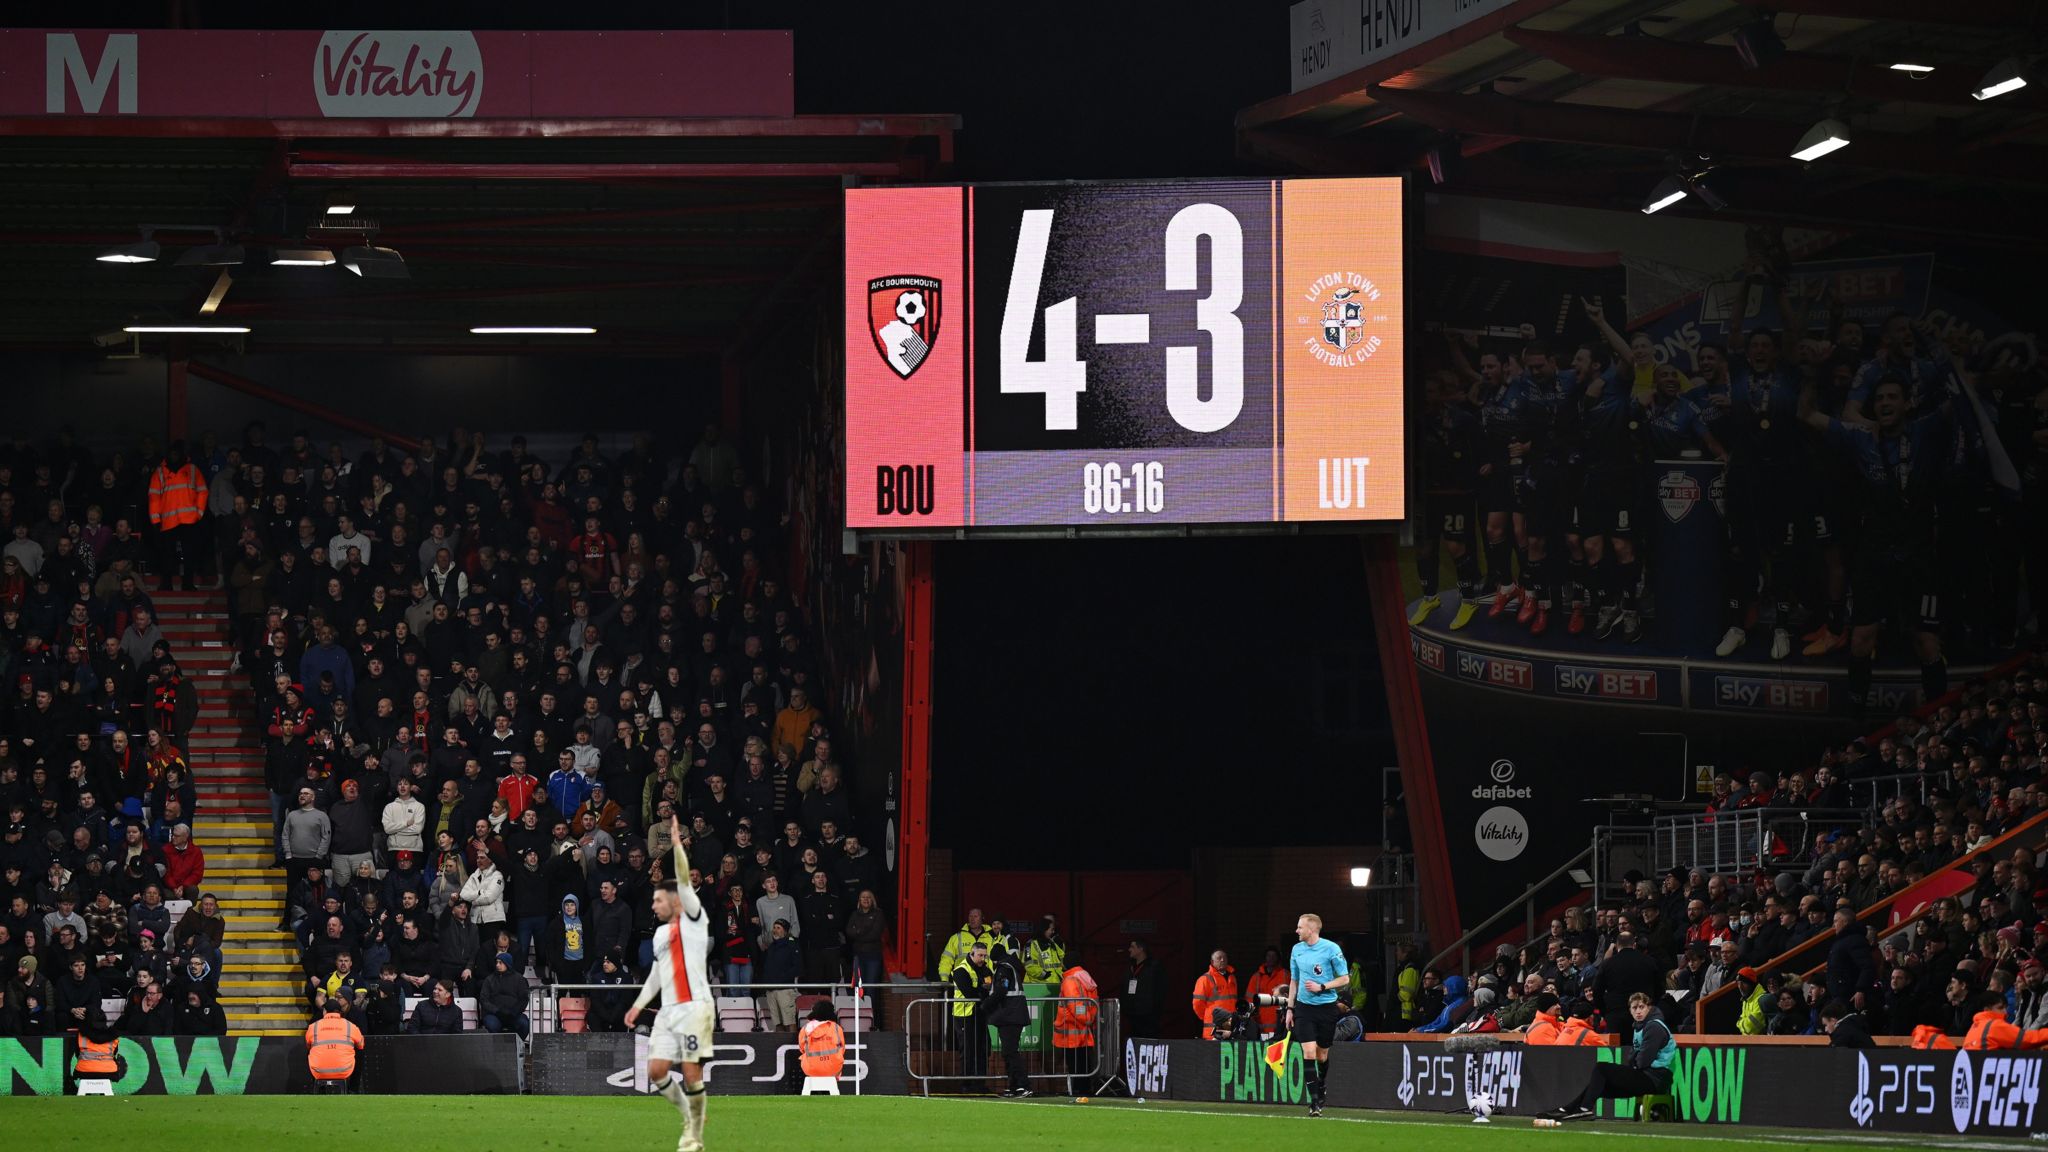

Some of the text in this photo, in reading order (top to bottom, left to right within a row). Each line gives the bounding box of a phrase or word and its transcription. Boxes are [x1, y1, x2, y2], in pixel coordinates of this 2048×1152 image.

[46, 34, 138, 114] M
[323, 33, 475, 117] Vitality
[1302, 39, 1331, 76] HENDY
[871, 278, 939, 290] AFC BOURNEMOUTH
[1305, 271, 1381, 302] LUTON TOWN
[1304, 335, 1381, 367] FOOTBALL CLUB
[876, 464, 935, 516] BOU
[1083, 461, 1165, 514] 86:16
[1318, 457, 1370, 509] LUT
[1674, 489, 1697, 498] BET
[1421, 639, 1441, 666] BET
[1460, 655, 1528, 686] sky BET
[1560, 670, 1650, 696] sky BET
[1720, 676, 1824, 708] sky BET
[1471, 785, 1532, 800] dafabet
[1481, 822, 1522, 846] Vitality
[1138, 1044, 1169, 1092] FC24
[1220, 1041, 1270, 1102] PLAY
[1417, 1055, 1455, 1096] PS5
[1480, 1051, 1523, 1108] FC24
[1671, 1046, 1746, 1122] NOW
[1879, 1065, 1935, 1113] PS5
[1973, 1058, 2042, 1127] FC24
